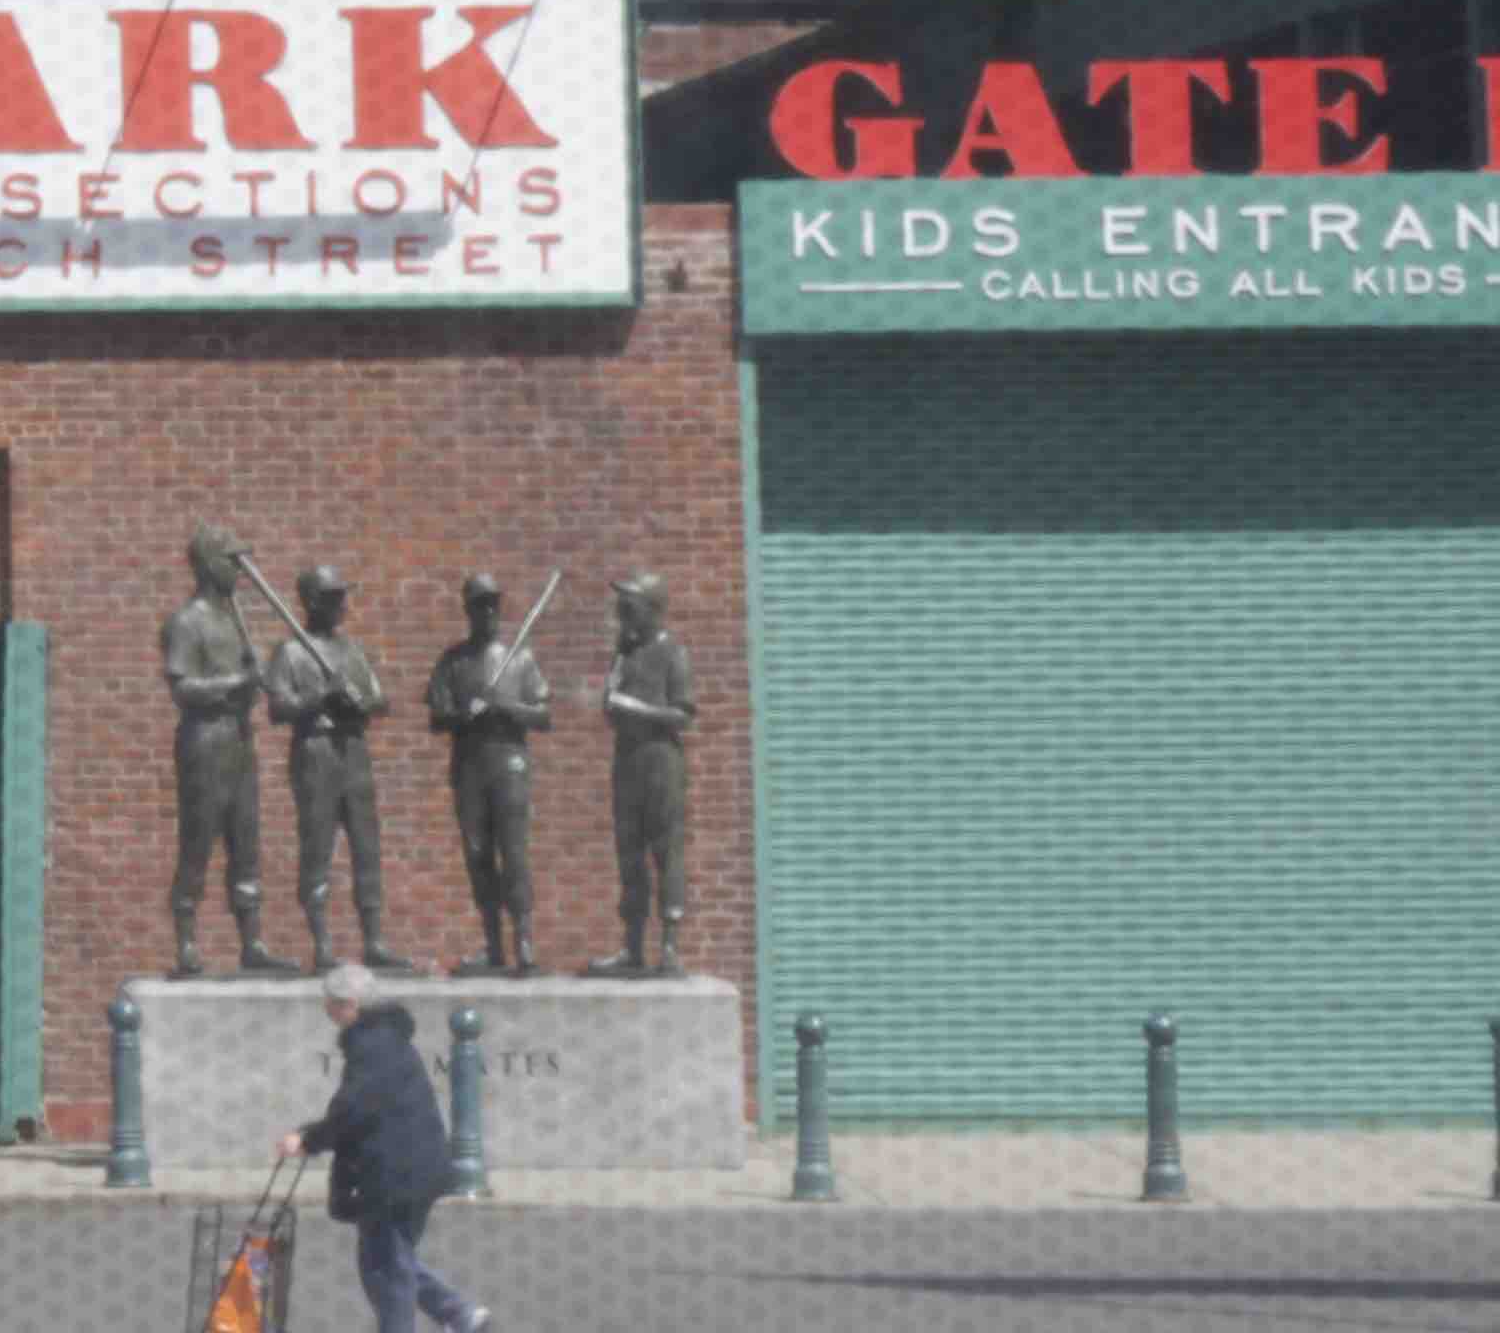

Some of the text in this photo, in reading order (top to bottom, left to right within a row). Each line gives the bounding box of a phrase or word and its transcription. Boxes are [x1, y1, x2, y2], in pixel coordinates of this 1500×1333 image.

[770, 57, 1390, 180] GATE
[2, 167, 563, 222] SECTIONS
[190, 232, 563, 278] STREET
[791, 203, 1500, 259] KIDS ENTRAN
[982, 263, 1467, 301] CALLING ALL KIDS
